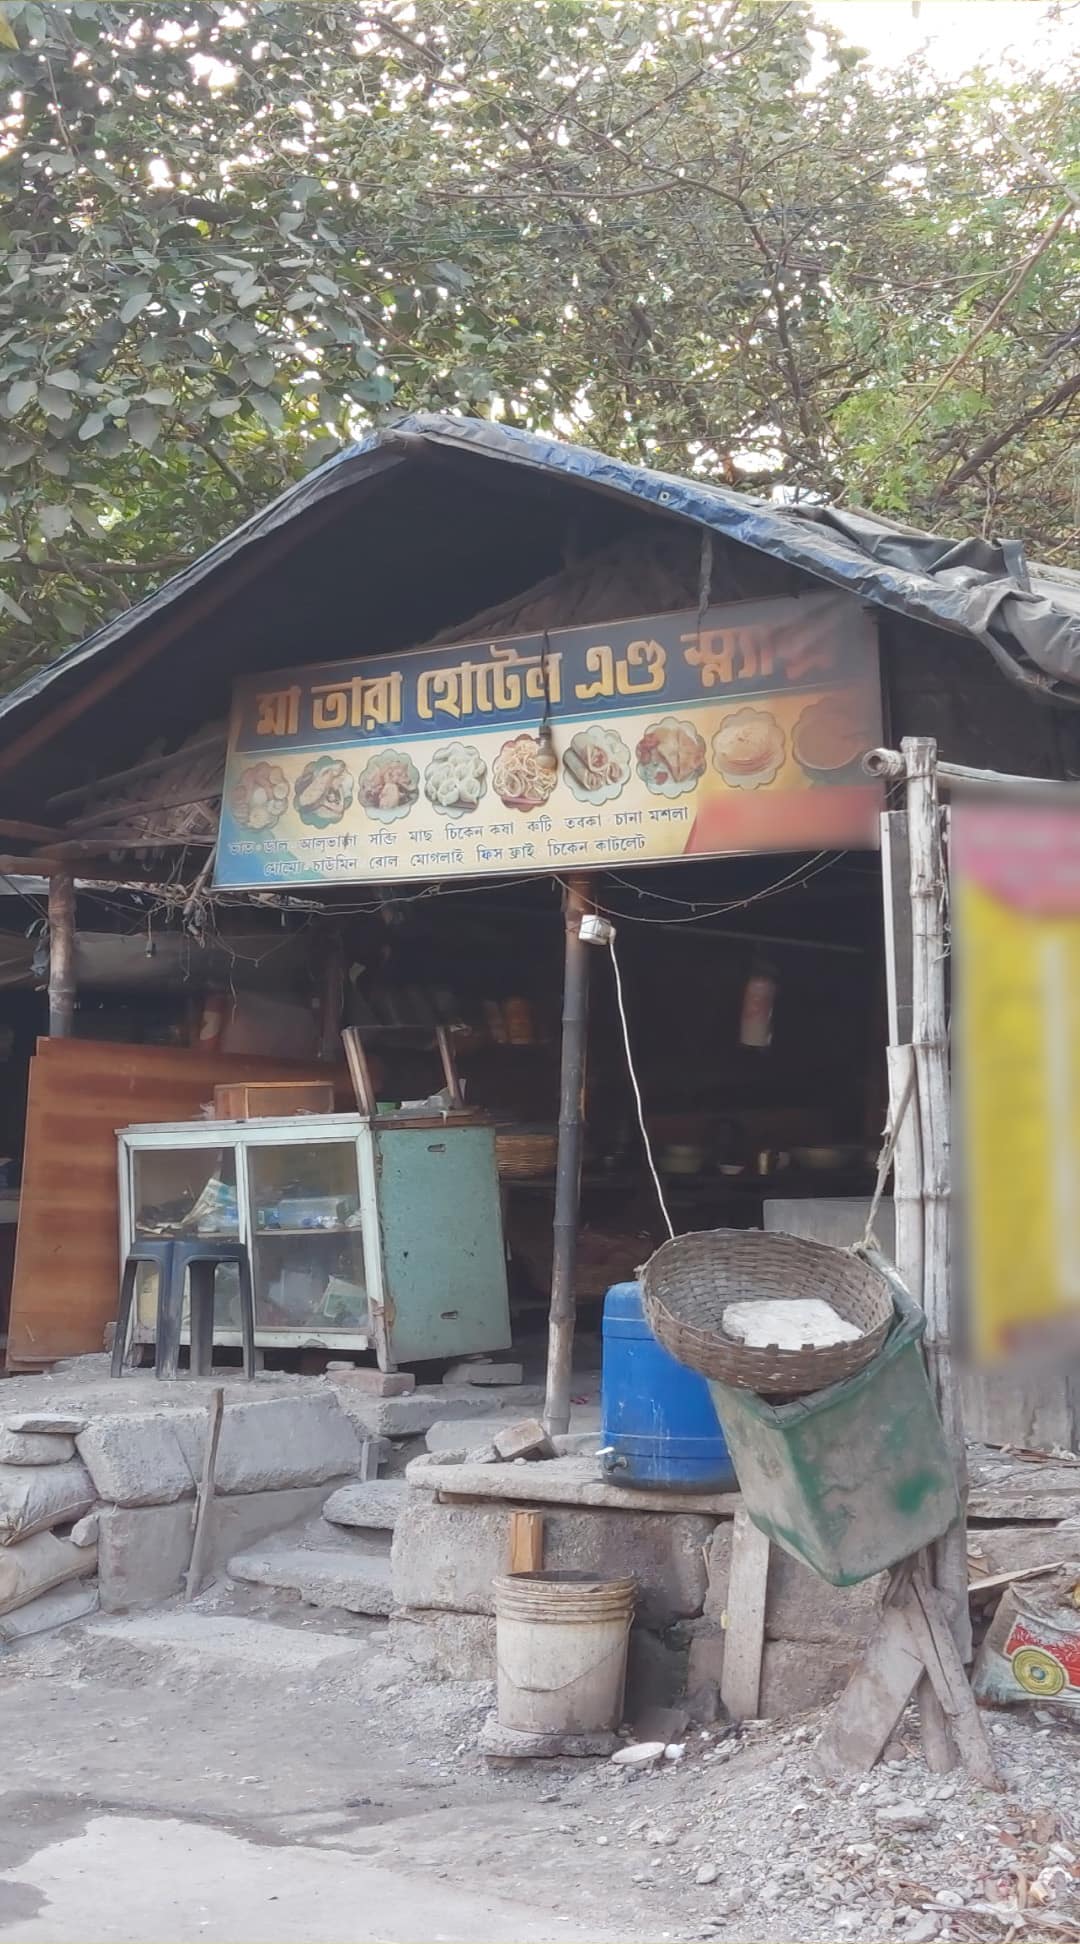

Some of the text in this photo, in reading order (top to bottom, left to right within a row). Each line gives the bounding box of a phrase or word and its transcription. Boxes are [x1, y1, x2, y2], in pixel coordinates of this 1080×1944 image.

[256, 686, 301, 736] মা
[311, 671, 403, 731] তারা
[416, 644, 562, 719] হোটেল
[263, 839, 289, 854] ডাল
[408, 829, 433, 843] মাছ
[446, 822, 484, 840] চিকেন
[489, 821, 514, 835] কষা
[527, 814, 552, 832] রুটি
[614, 810, 642, 826] চানা
[648, 806, 688, 821] মশলা
[312, 853, 358, 872] চাউমিন
[369, 855, 399, 870] রোল
[410, 848, 465, 867] মোগলাই
[547, 838, 587, 856] চিকেন
[594, 833, 647, 852] কাটলেট
